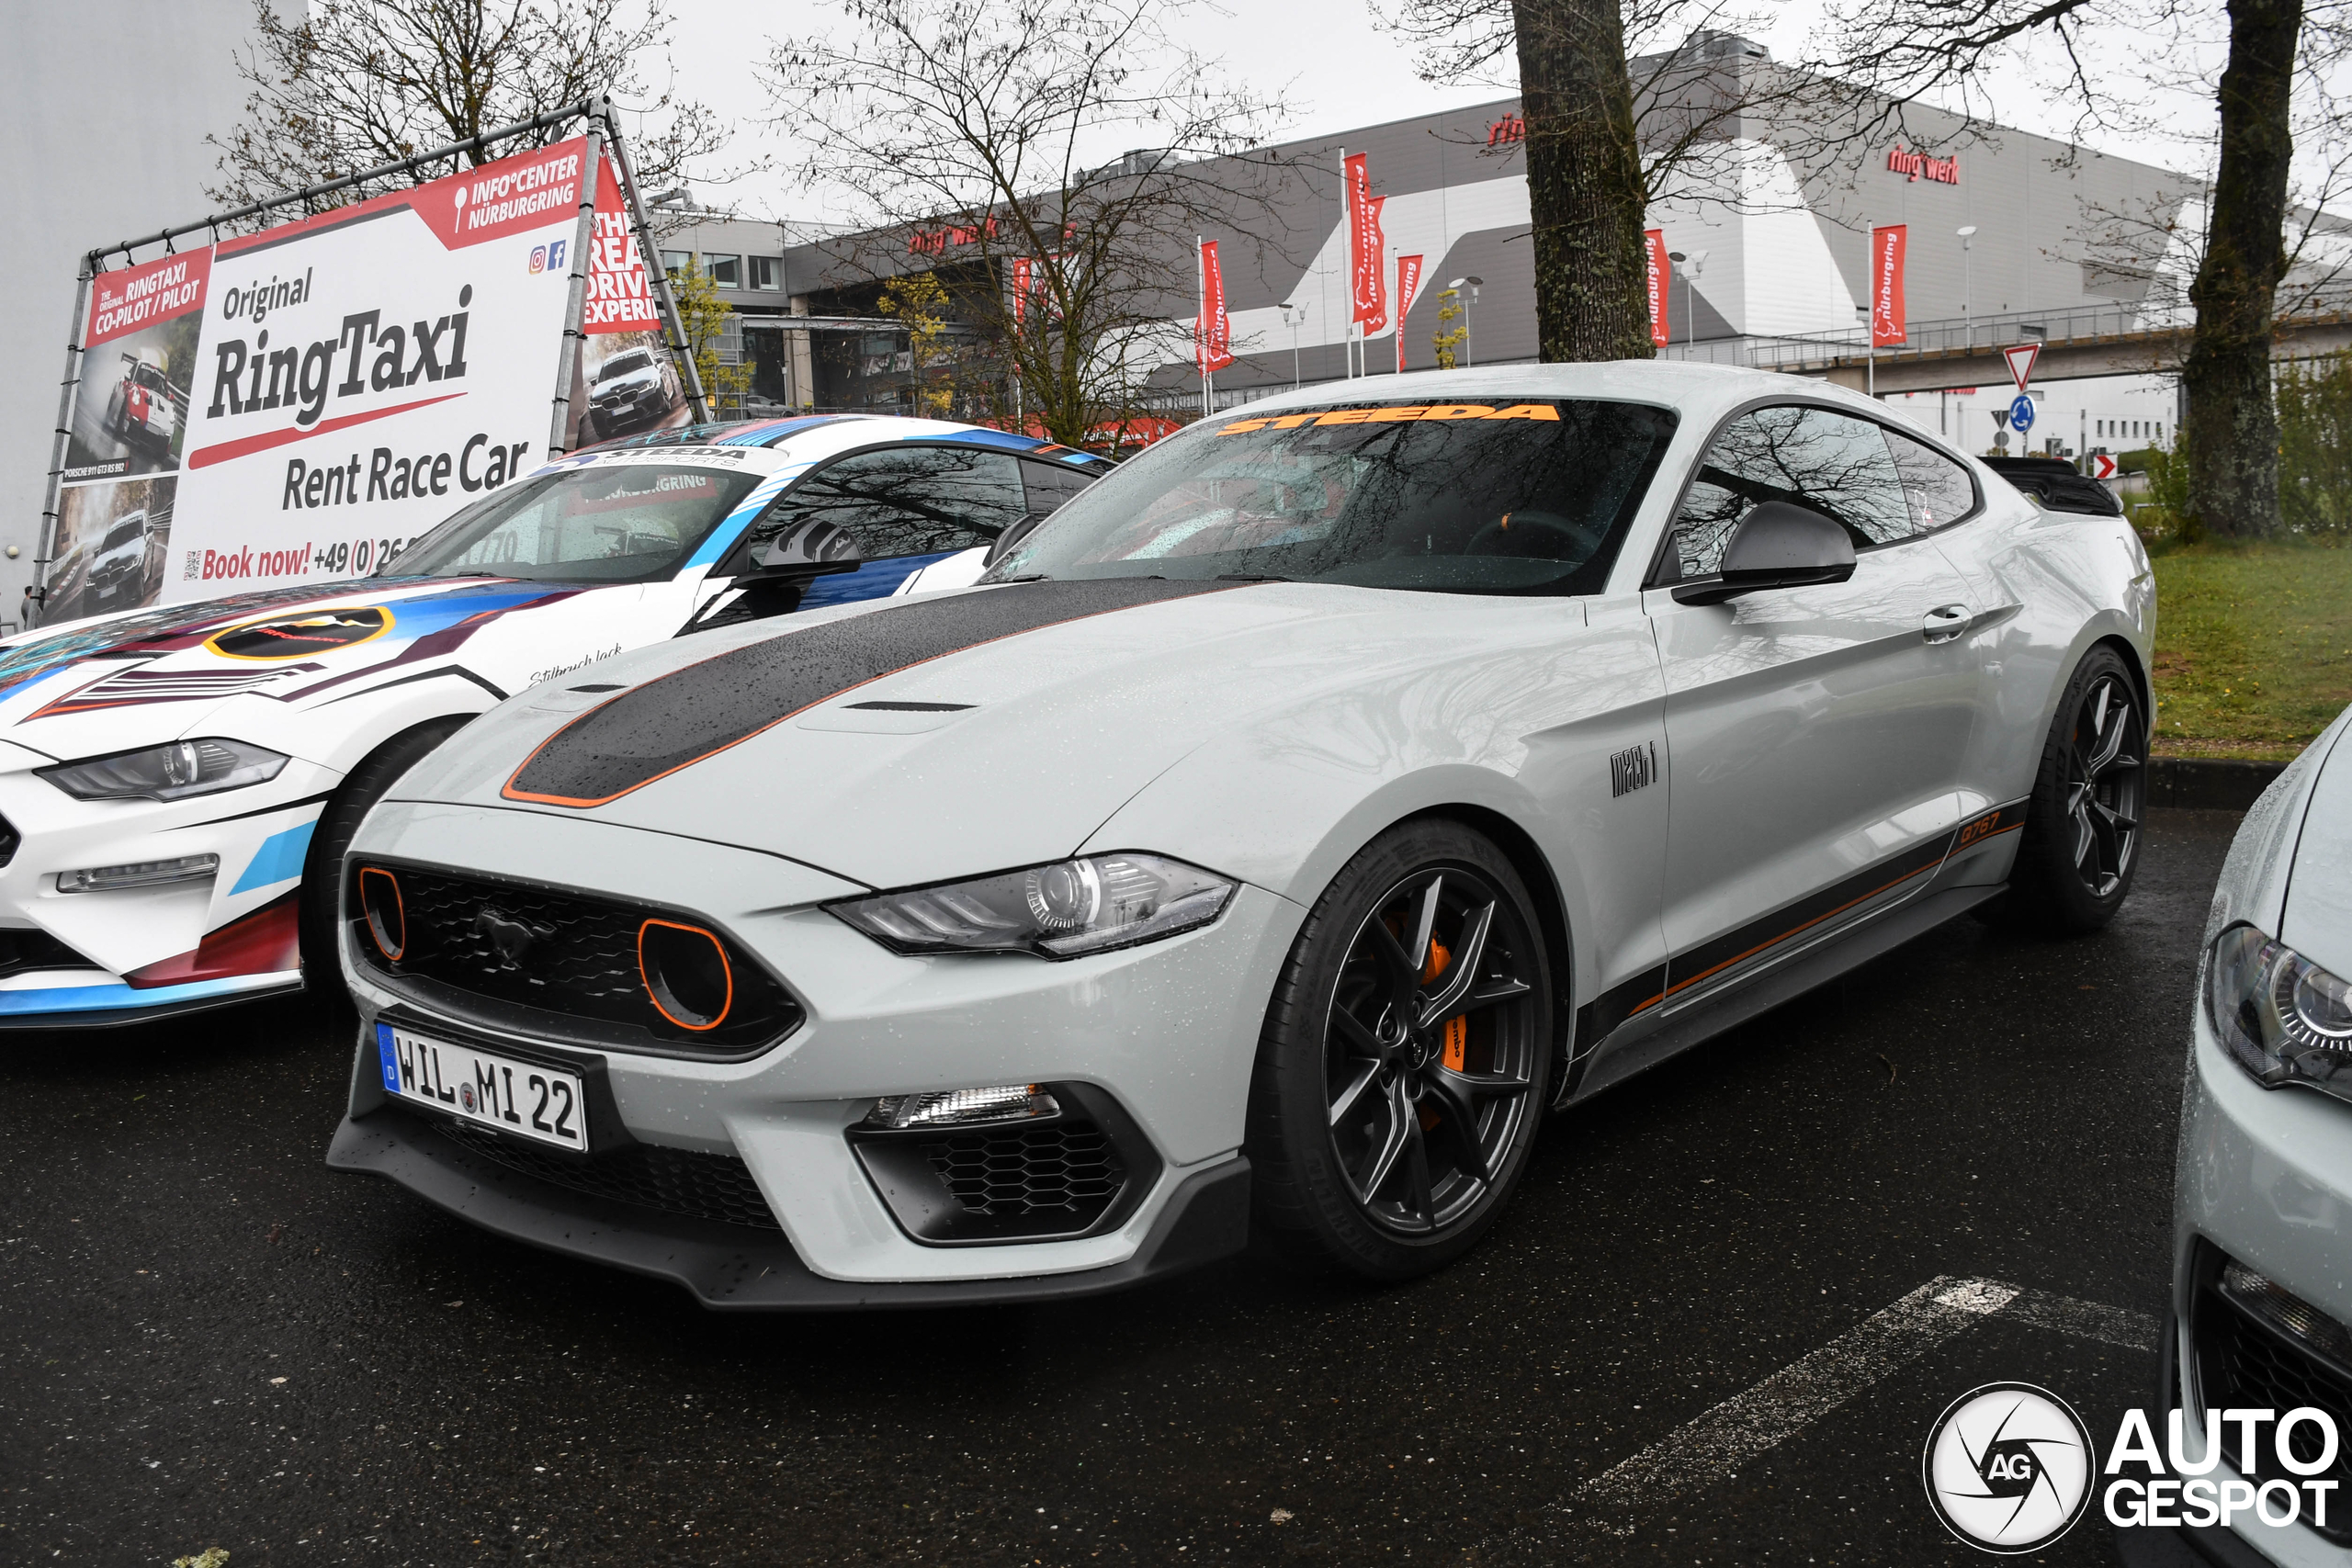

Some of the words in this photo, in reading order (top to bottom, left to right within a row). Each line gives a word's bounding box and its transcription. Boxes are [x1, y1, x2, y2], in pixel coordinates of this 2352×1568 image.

[469, 183, 574, 230] NÜRBURGRING
[101, 290, 111, 301] THE
[126, 262, 187, 302] RINGTAXI
[223, 266, 312, 323] Original
[96, 298, 152, 334] CO-PILOT
[161, 279, 199, 311] PILOT
[99, 296, 123, 311] ORIGINAL
[207, 283, 472, 426] RingTaxi
[1216, 404, 1560, 436] STEEDA
[97, 464, 107, 475] GT3
[282, 453, 361, 511] Rent
[368, 446, 452, 502] Race
[459, 433, 529, 492] Car
[596, 457, 739, 467] AUTOSPORTS
[605, 448, 746, 459] STEEDA
[202, 545, 254, 580] Book
[257, 542, 311, 576] now!
[387, 1065, 395, 1080] D
[395, 1035, 457, 1104] WIL
[474, 1058, 521, 1124] MI
[528, 1074, 577, 1140] 22
